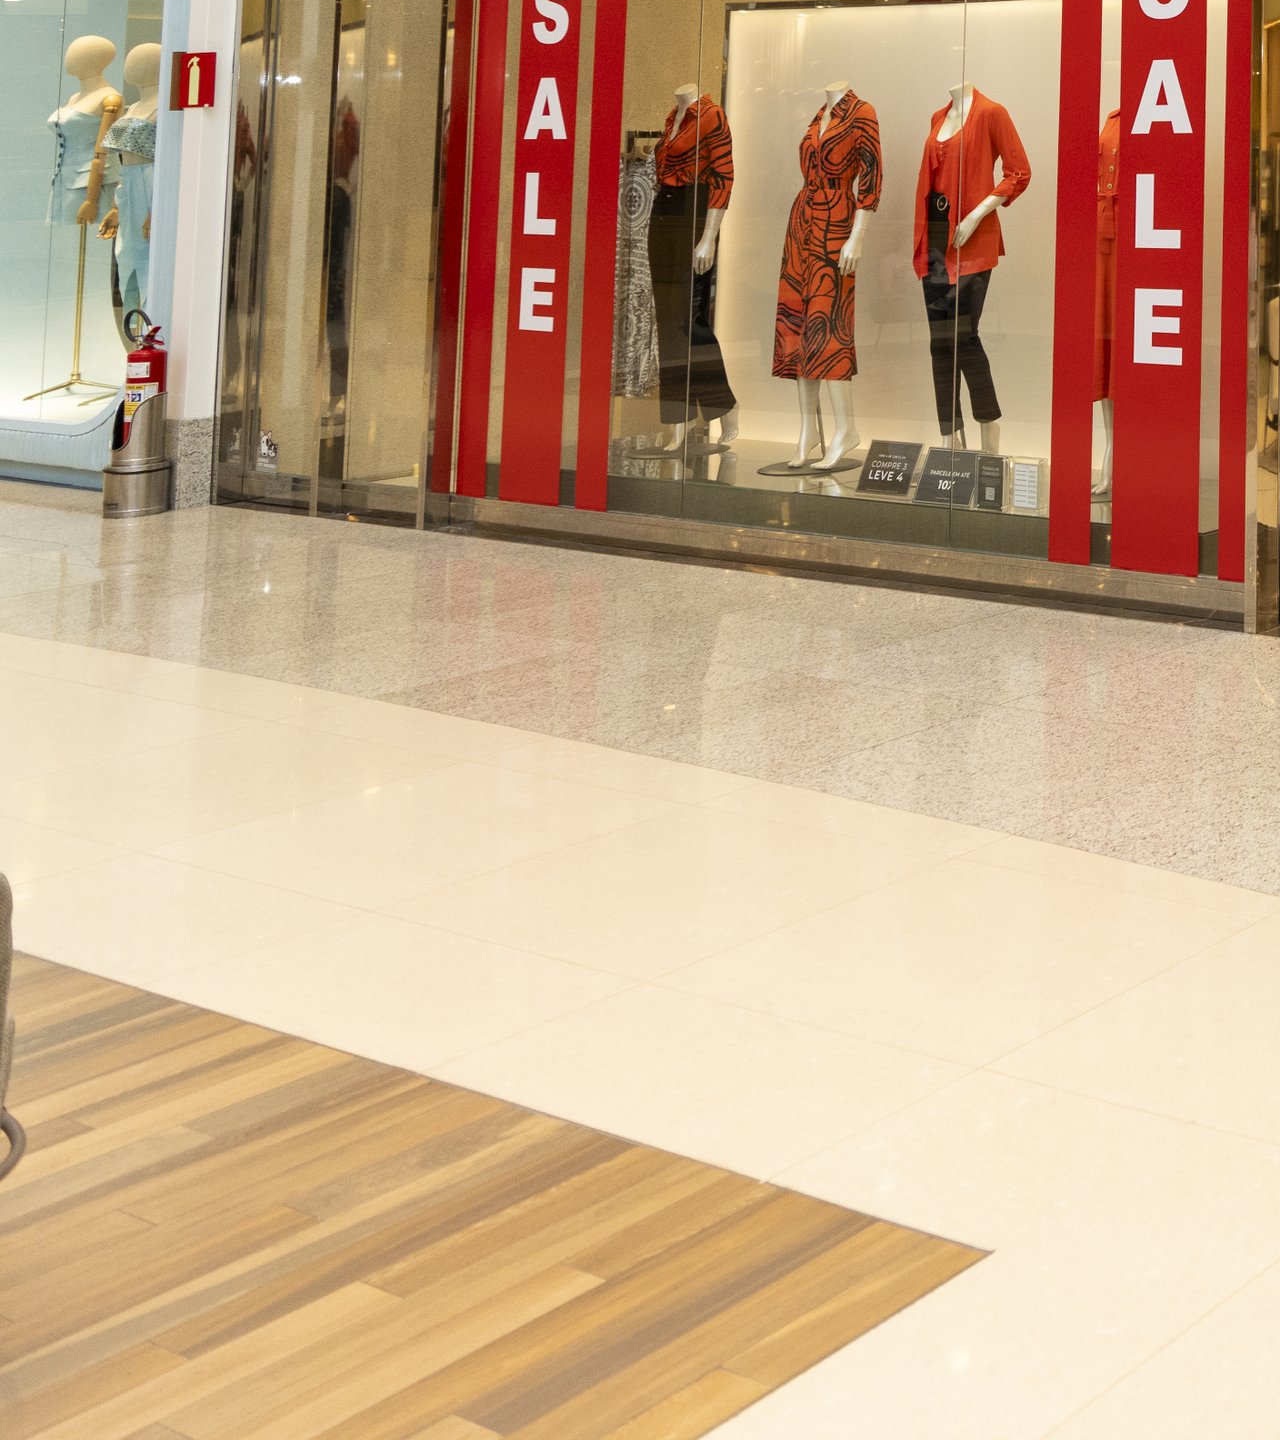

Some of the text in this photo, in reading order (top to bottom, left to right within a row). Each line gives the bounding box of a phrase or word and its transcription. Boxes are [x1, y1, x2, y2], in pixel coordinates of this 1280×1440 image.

[871, 460, 908, 471] COMPRE 3
[868, 470, 904, 482] LEVE 4
[960, 471, 971, 479] ATÉ
[937, 479, 955, 491] 10X
